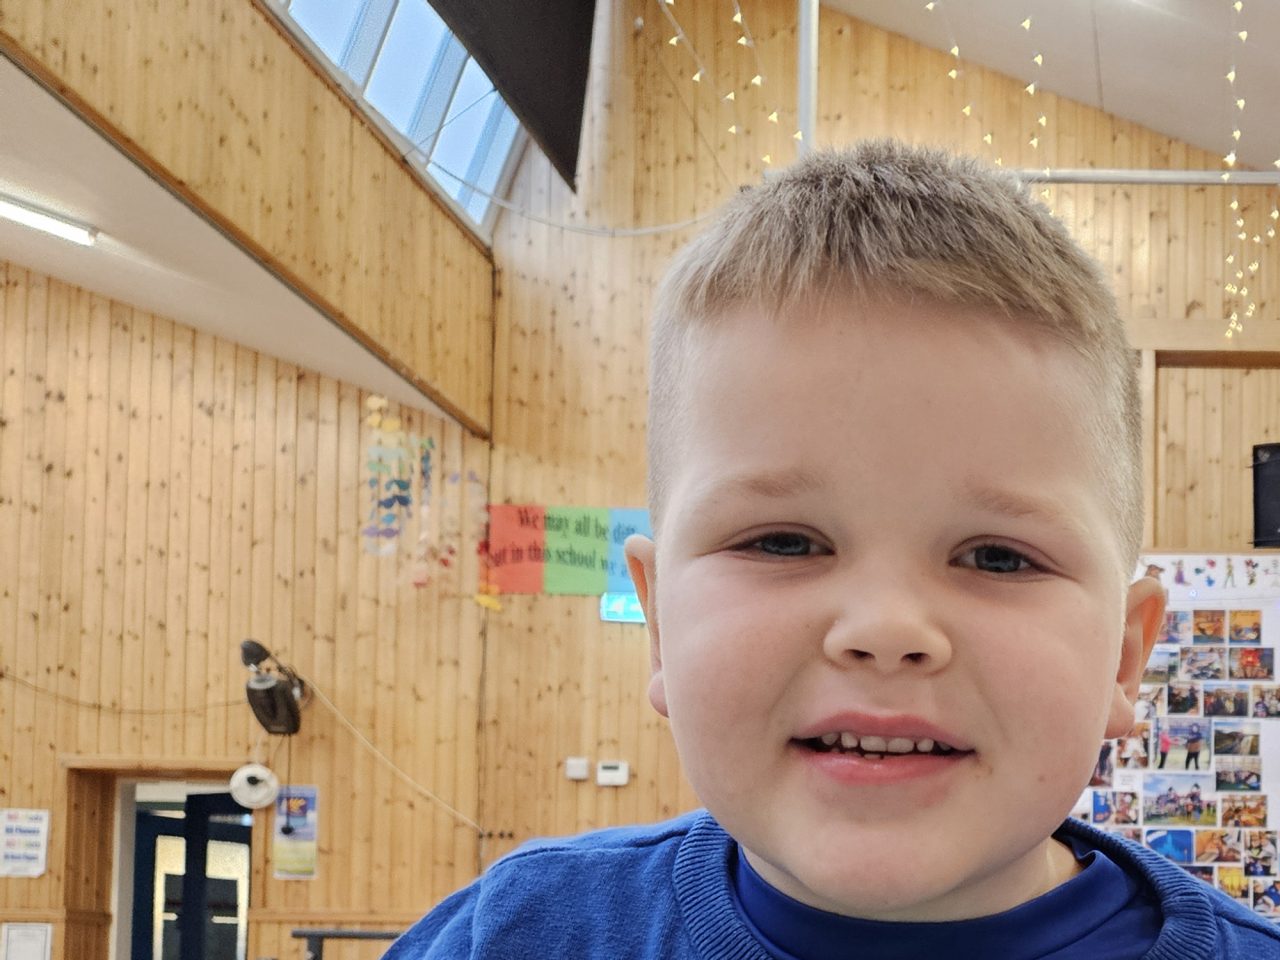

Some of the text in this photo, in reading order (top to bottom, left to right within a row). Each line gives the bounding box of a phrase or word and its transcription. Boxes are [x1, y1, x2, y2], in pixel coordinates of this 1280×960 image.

[575, 514, 590, 538] all
[511, 541, 523, 562] in
[528, 540, 551, 562] this
[556, 544, 596, 570] school
